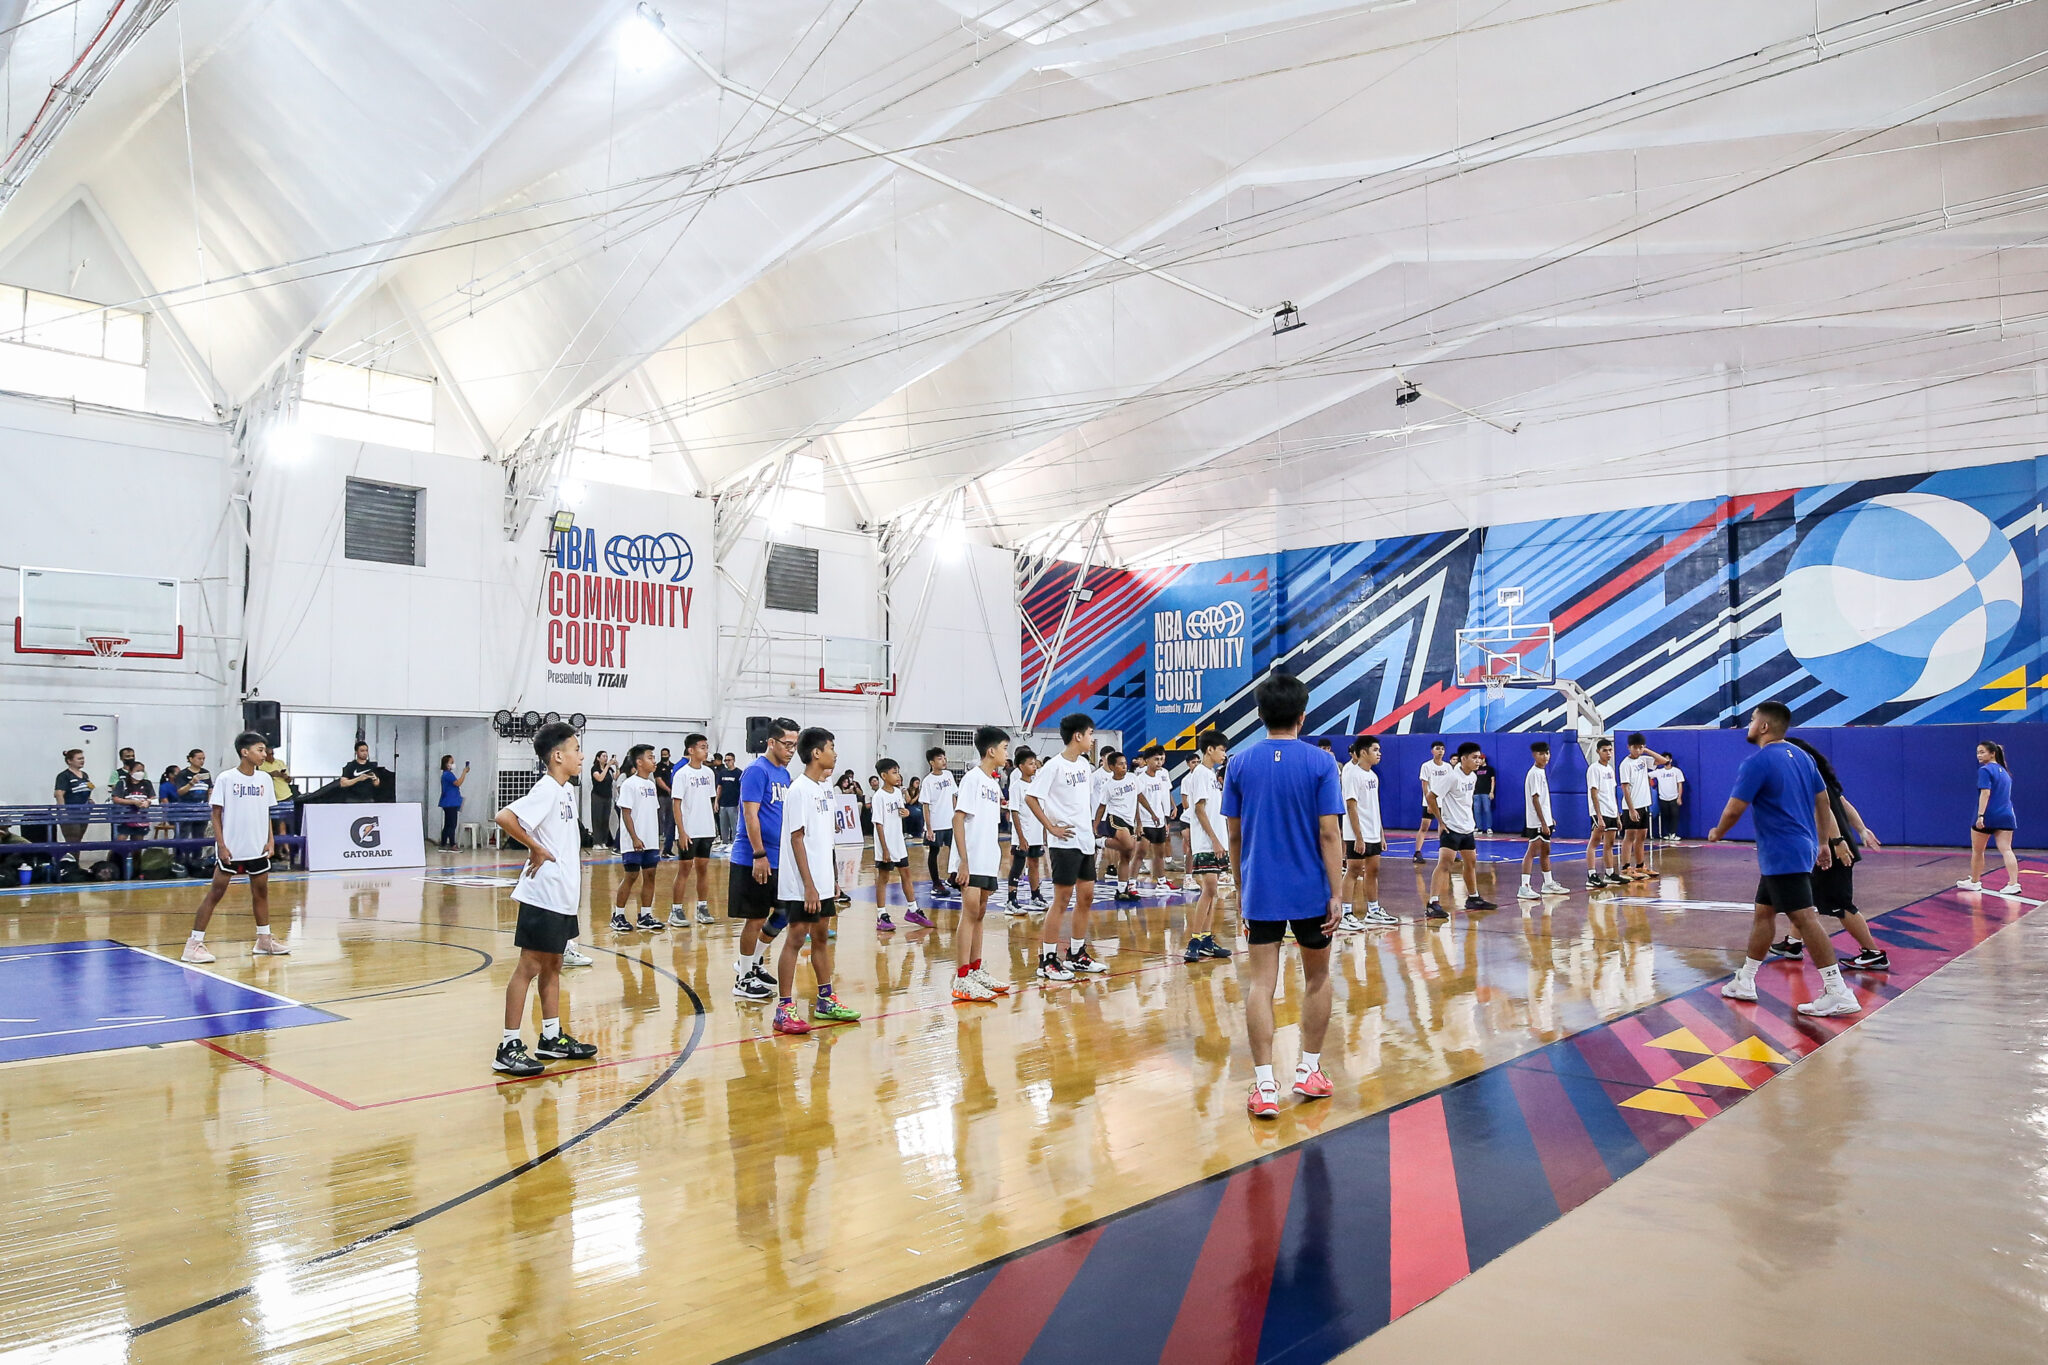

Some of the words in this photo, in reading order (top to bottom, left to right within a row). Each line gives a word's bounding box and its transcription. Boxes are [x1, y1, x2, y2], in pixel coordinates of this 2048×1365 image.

[548, 571, 693, 629] COMMUNITY
[1155, 610, 1183, 642] NBA
[548, 619, 631, 668] COURT
[1154, 637, 1244, 672] COMMUNITY
[547, 669, 583, 685] Presented
[583, 671, 593, 687] by
[597, 672, 628, 688] TITAN
[1154, 670, 1203, 701] COURT
[350, 816, 381, 849] G
[343, 850, 393, 858] GATORADE
